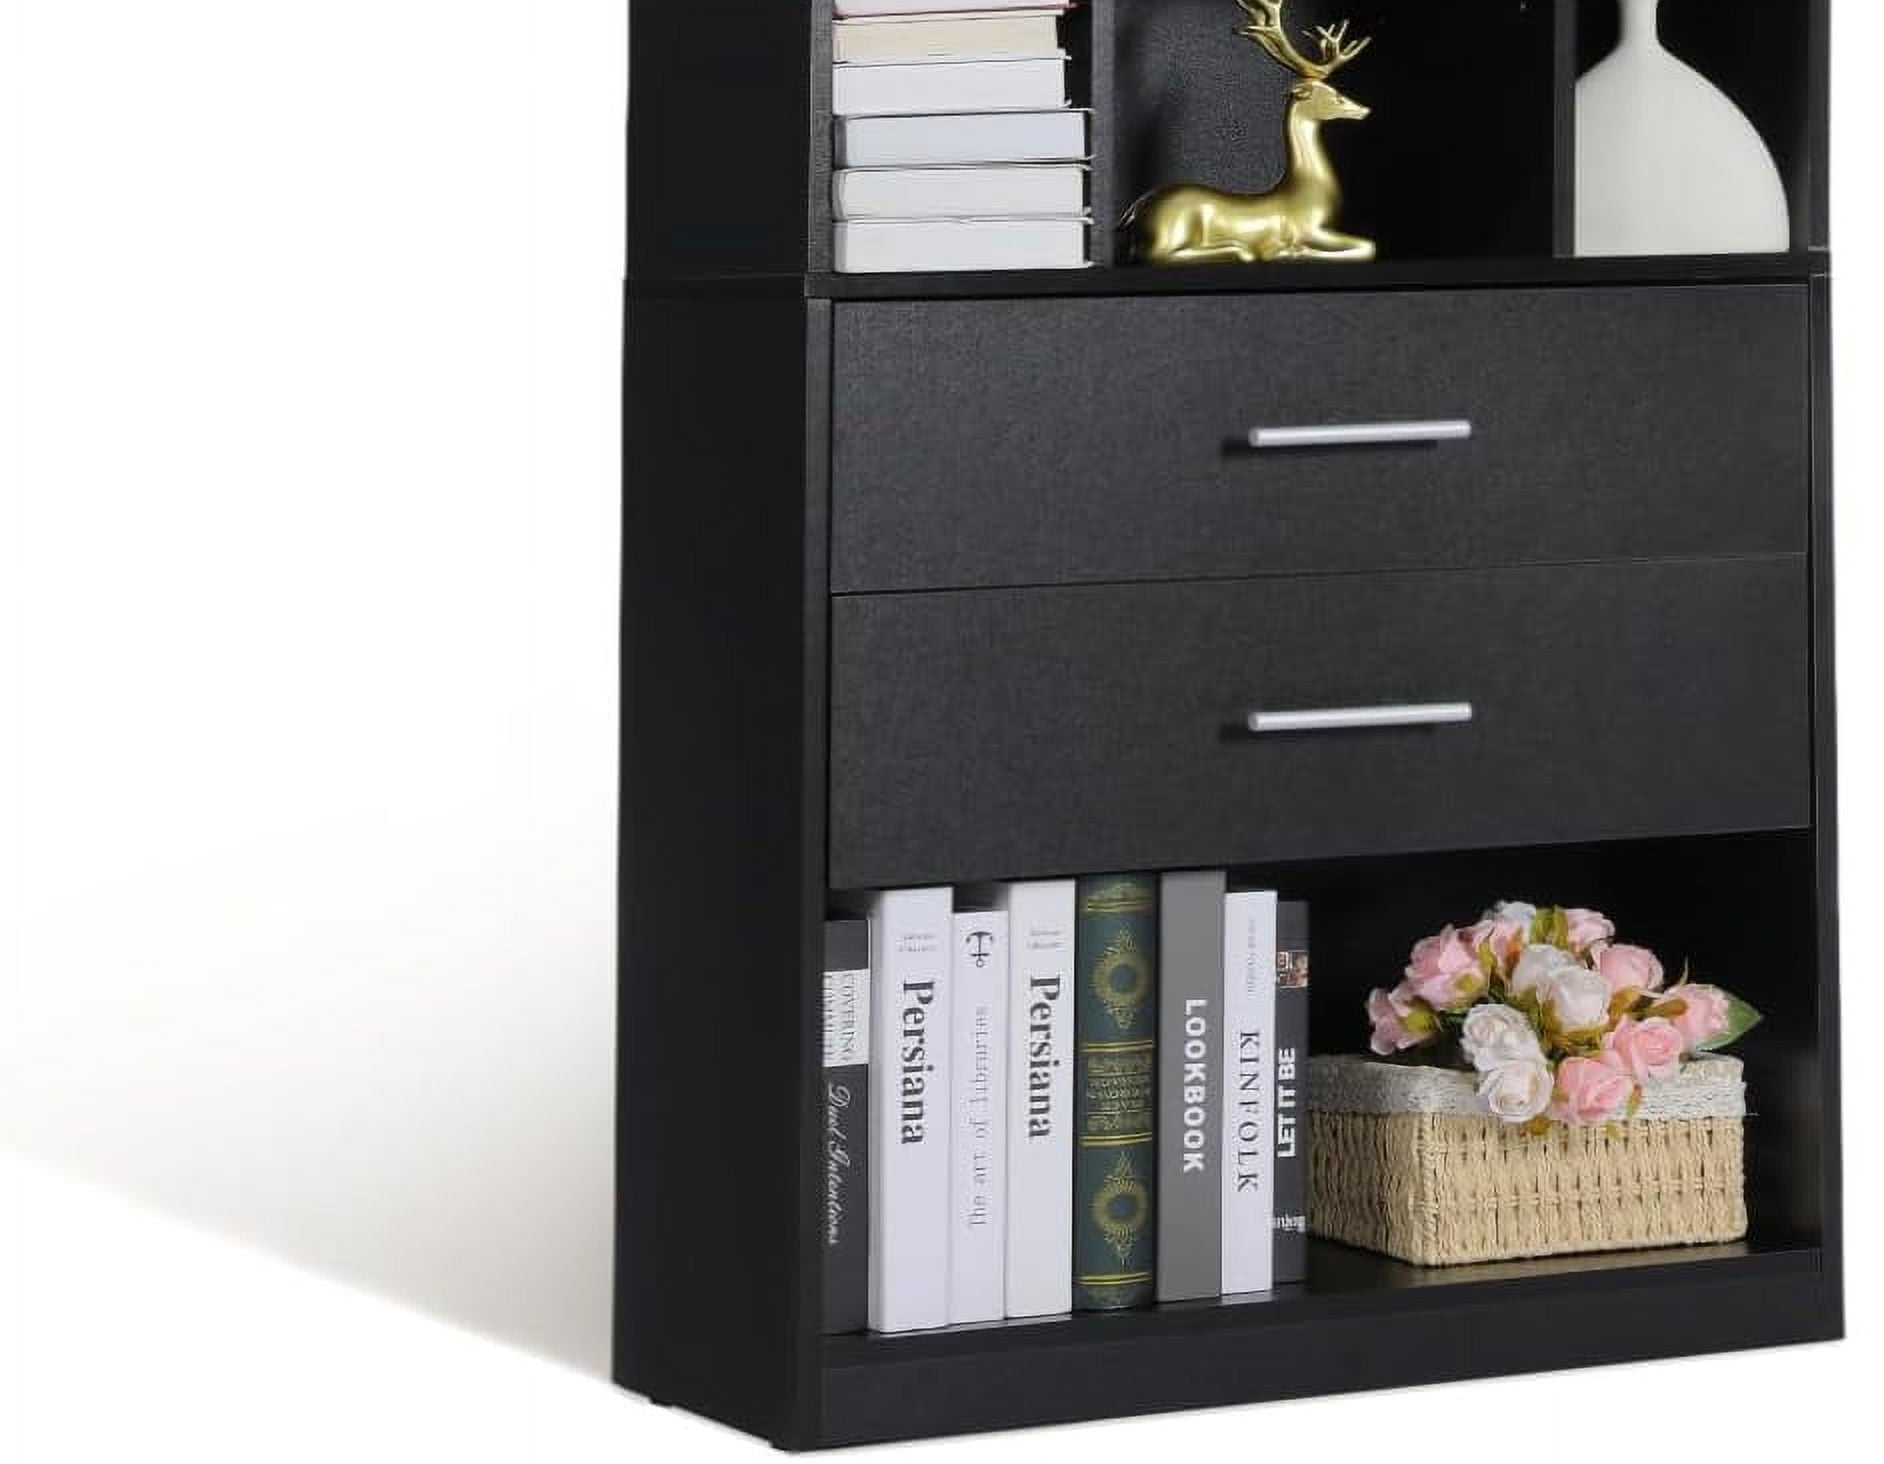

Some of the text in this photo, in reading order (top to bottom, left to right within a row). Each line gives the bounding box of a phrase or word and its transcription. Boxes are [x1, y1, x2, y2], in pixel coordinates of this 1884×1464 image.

[901, 979, 934, 1145] Persiana
[1028, 977, 1061, 1139] Persiana
[1183, 998, 1208, 1175] LOOKBOOK
[1237, 1031, 1260, 1194] KINFOLK
[1277, 1047, 1296, 1158] LET IT BE
